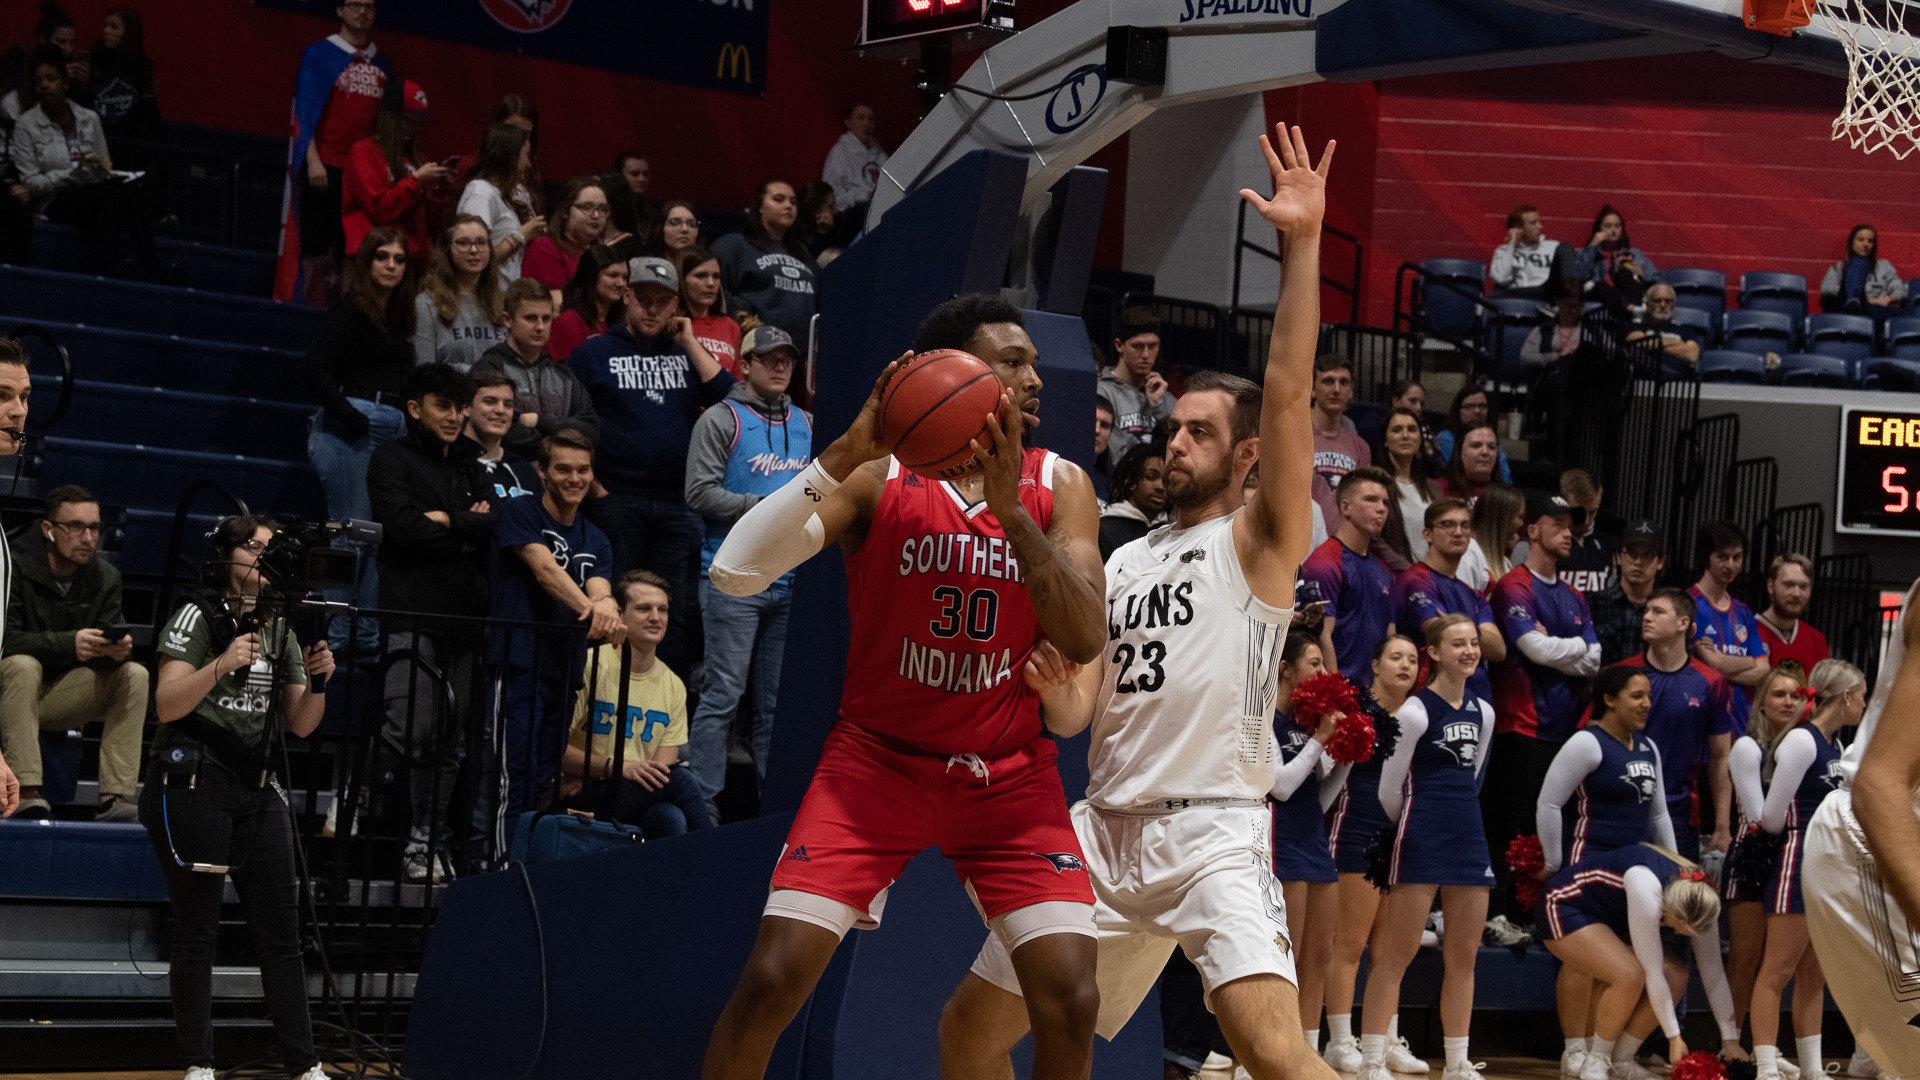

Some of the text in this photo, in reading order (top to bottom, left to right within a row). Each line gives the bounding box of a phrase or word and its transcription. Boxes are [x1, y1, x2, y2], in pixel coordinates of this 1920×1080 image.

[348, 71, 378, 87] SIDE
[747, 452, 809, 477] Miami
[899, 532, 1026, 584] SOUTHER
[1559, 566, 1610, 592] HEAT
[929, 584, 1000, 642] 30
[164, 641, 187, 653] adidas
[899, 636, 1012, 694] INDIANA
[1112, 640, 1168, 694] 23
[1446, 723, 1480, 743] USI
[1628, 762, 1657, 779] USI
